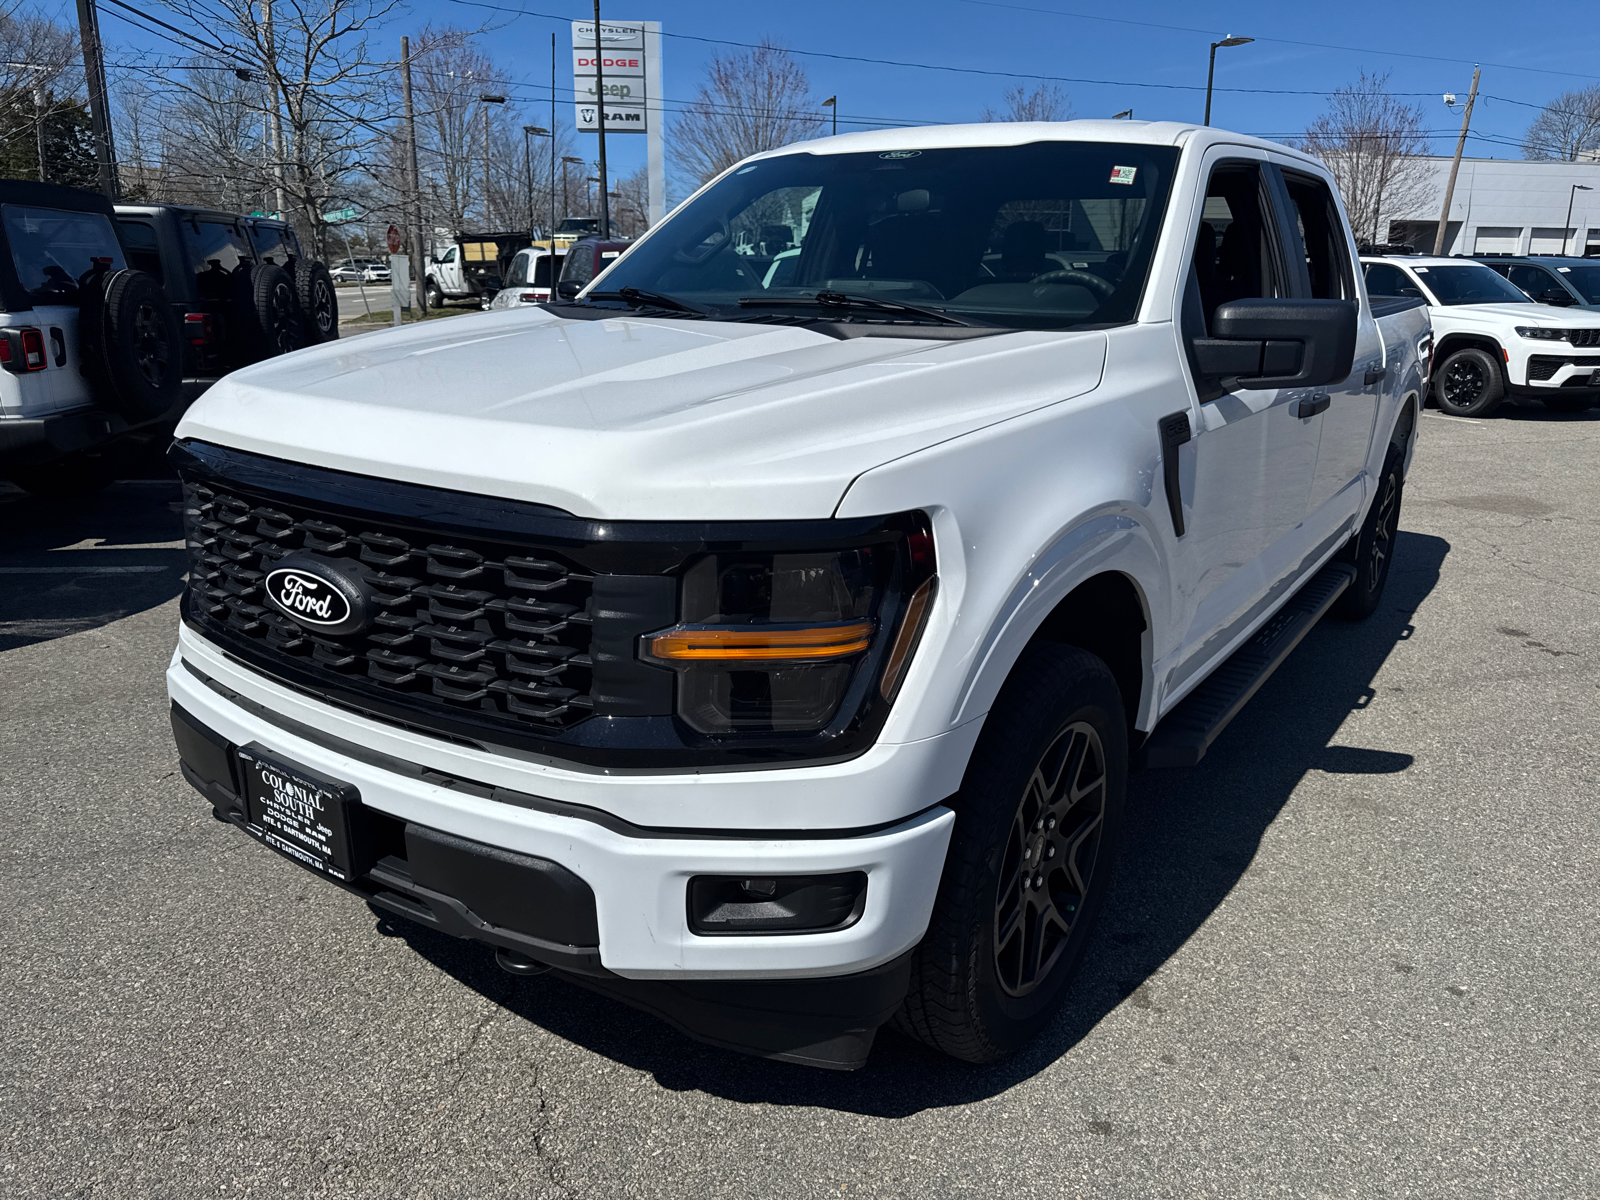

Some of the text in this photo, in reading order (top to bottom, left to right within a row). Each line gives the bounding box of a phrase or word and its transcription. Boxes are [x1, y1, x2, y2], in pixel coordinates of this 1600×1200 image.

[588, 81, 631, 99] Jeep
[602, 113, 641, 121] RAM
[281, 574, 332, 618] Ford
[261, 770, 324, 812] COLONIAL
[273, 788, 315, 820] SOUTH
[260, 796, 333, 837] CHRYSLER Jeep
[267, 807, 326, 842] DODGE RAM
[321, 844, 332, 856] MA
